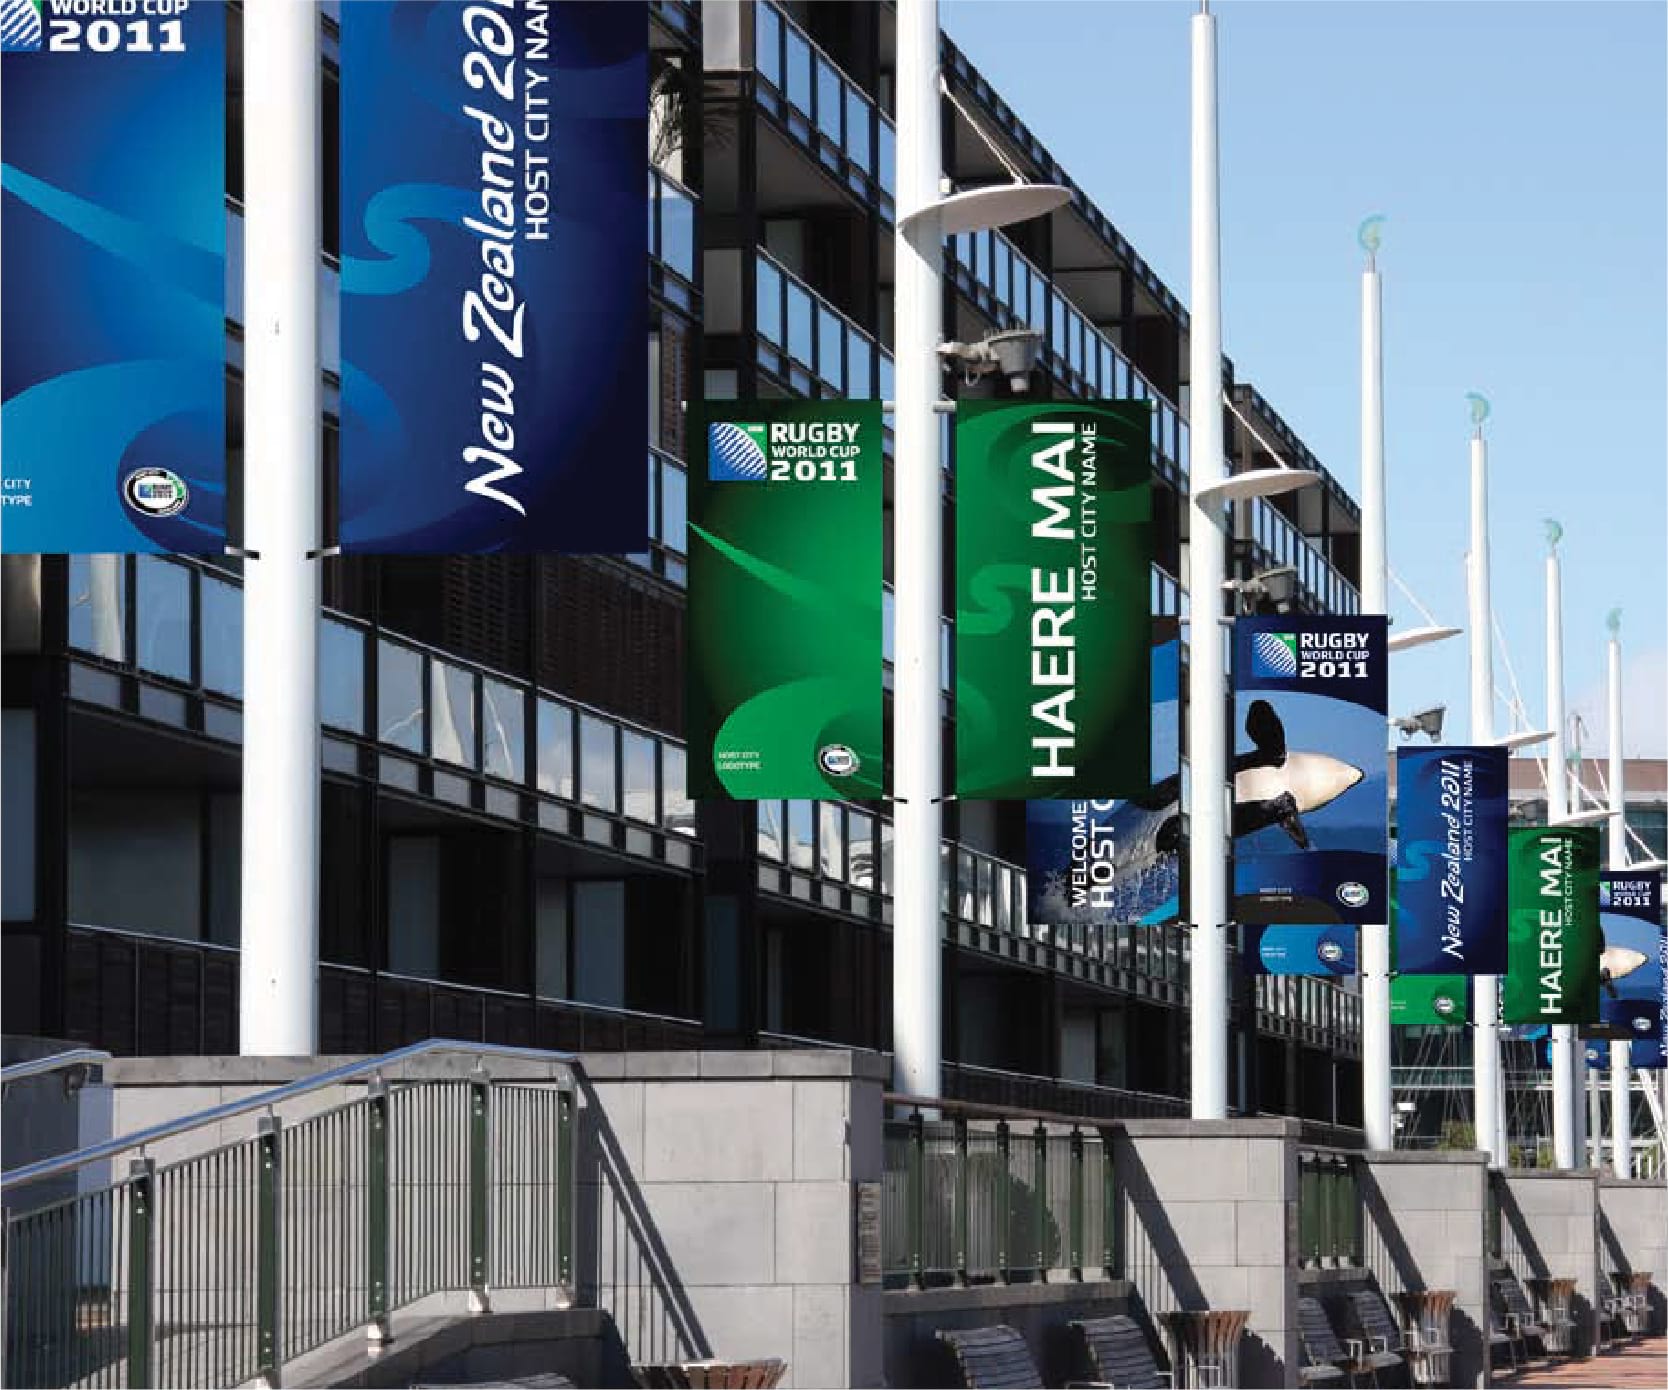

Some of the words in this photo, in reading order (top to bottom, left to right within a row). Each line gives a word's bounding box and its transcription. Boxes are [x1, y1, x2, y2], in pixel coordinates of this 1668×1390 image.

[49, 19, 186, 52] 2011
[51, 0, 137, 15] WORLD
[143, 0, 190, 15] CUP
[524, 67, 549, 141] CITY
[524, 148, 549, 240] HOST
[462, 104, 526, 358] Zealand
[462, 362, 526, 517] New
[770, 423, 861, 443] RUGBY
[771, 445, 828, 458] WORLD
[829, 445, 861, 458] CUP
[1081, 423, 1096, 486] NAME
[770, 460, 858, 481] 2011
[1031, 423, 1076, 540] MAI
[1081, 492, 1096, 538] CITY
[1081, 542, 1096, 600] HOST
[1301, 632, 1369, 648] RUGBY
[1301, 650, 1345, 660] WORLD
[1346, 650, 1370, 660] CUP
[1031, 567, 1076, 777] HAERE
[1301, 661, 1369, 678] 2011
[1441, 760, 1460, 813] 2011
[1071, 800, 1087, 908] WELCOME
[1090, 818, 1115, 908] HOST
[1441, 812, 1464, 904] Zealand
[1540, 837, 1562, 897] MAI
[1612, 896, 1650, 906] 2011
[1441, 904, 1465, 962] New
[1540, 909, 1562, 1014] HAERE
